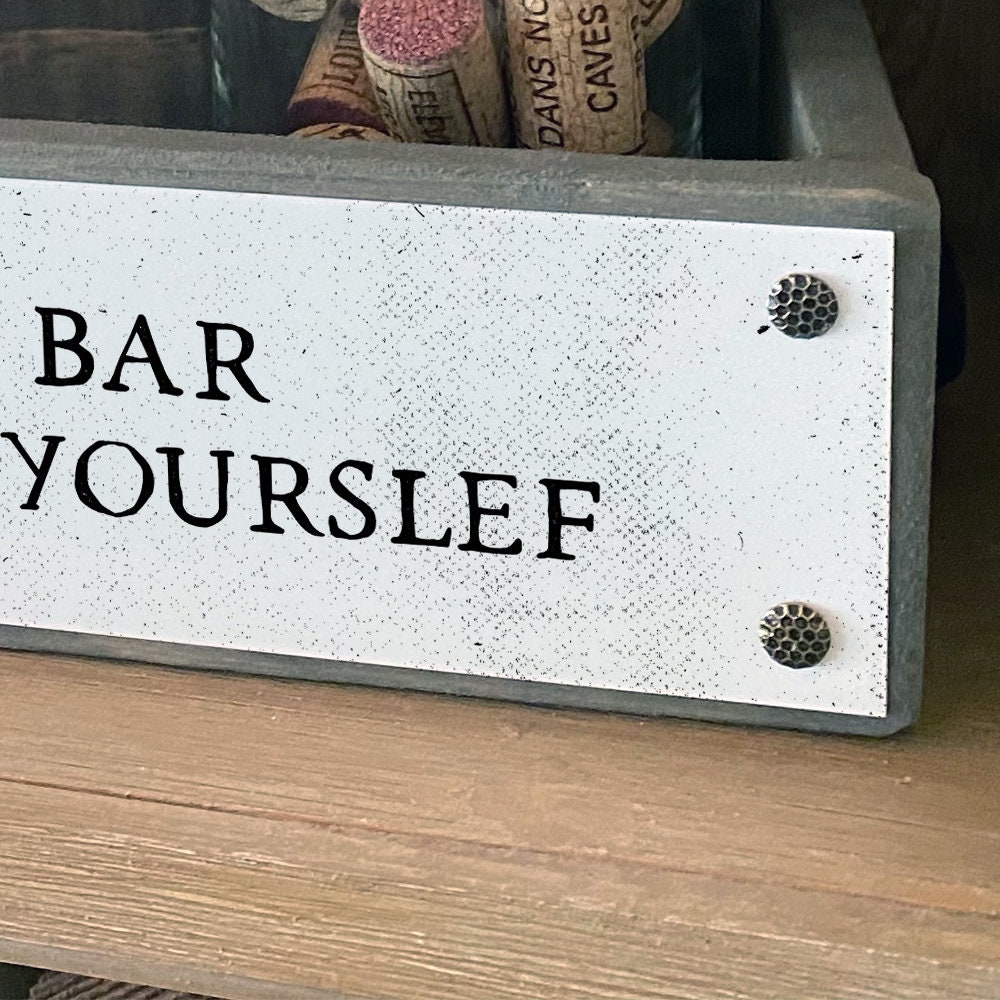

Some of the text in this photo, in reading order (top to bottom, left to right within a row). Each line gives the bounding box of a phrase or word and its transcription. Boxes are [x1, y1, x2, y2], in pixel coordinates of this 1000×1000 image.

[527, 55, 565, 148] DANS
[577, 3, 619, 113] CAVES
[35, 306, 270, 403] BAR
[0, 432, 600, 560] YOURSLEF
